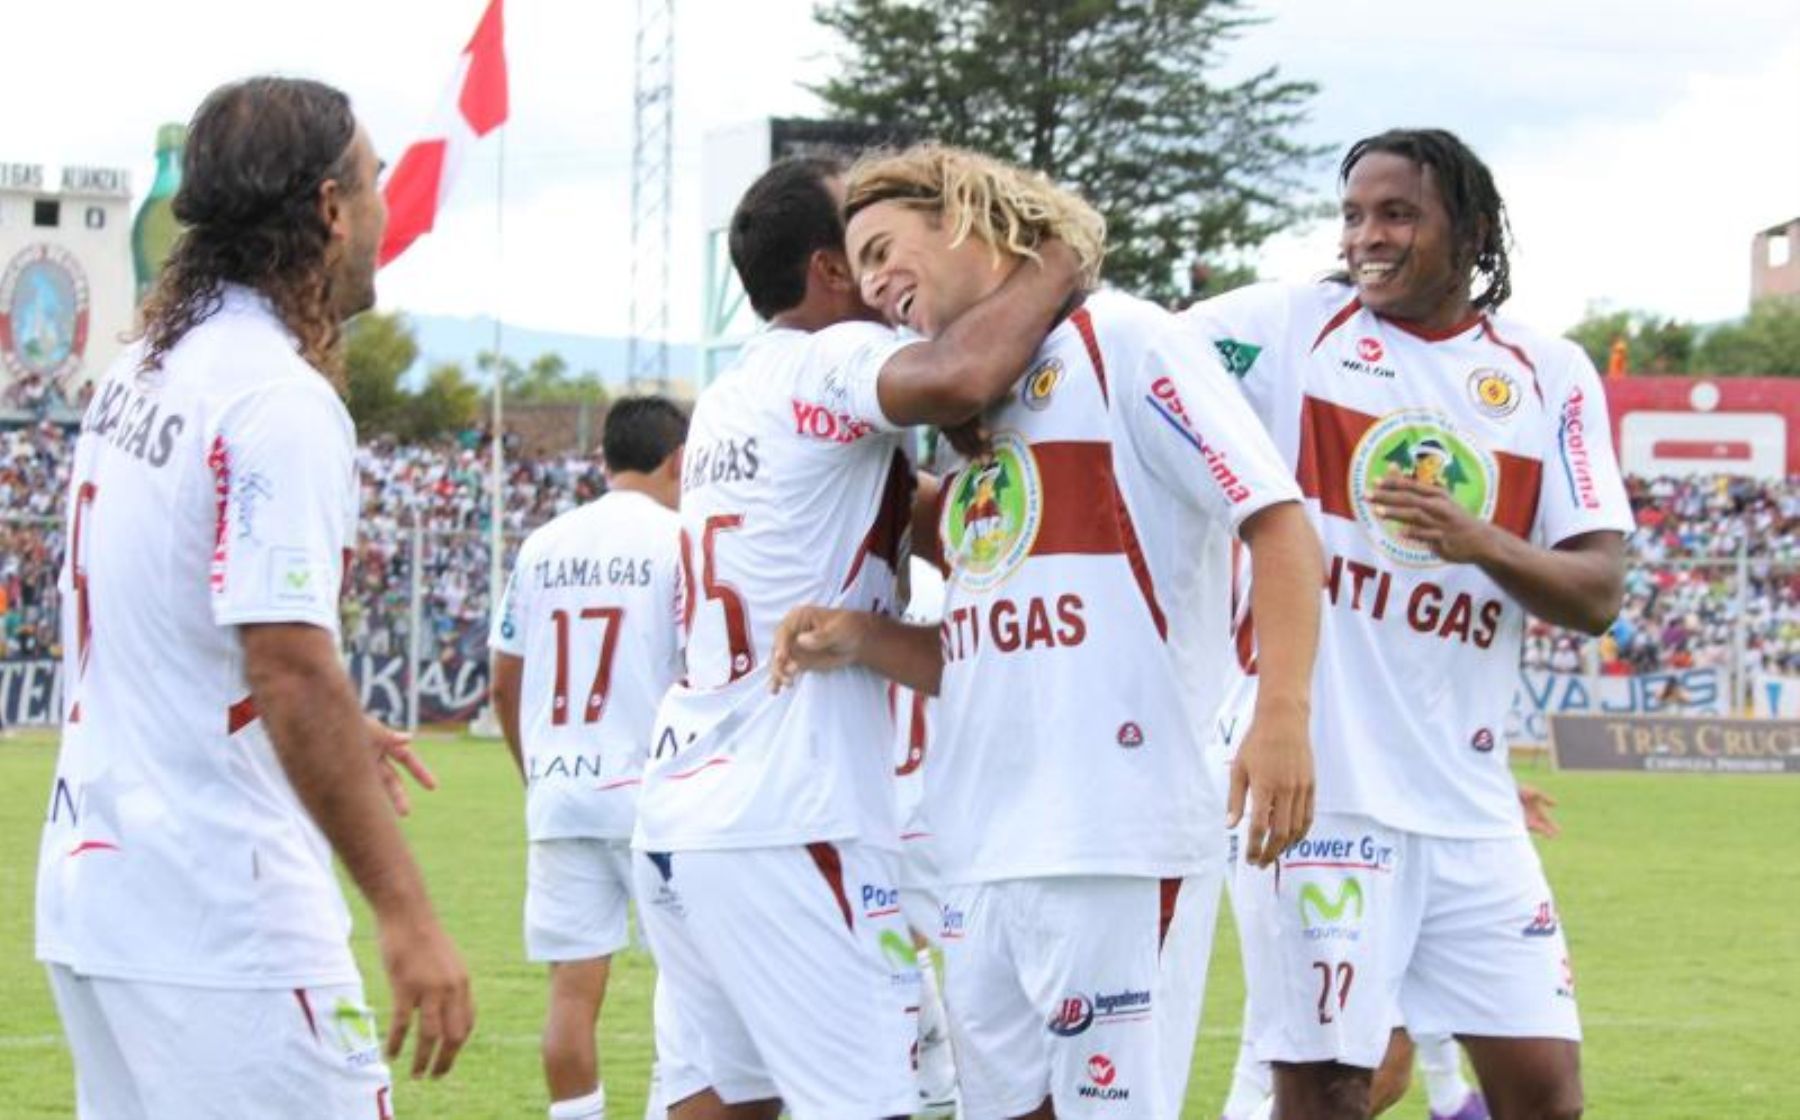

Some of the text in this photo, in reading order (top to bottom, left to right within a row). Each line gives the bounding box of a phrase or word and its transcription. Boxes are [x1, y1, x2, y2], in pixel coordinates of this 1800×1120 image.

[711, 437, 758, 482] GAS
[608, 557, 653, 588] GAS
[989, 593, 1087, 653] GAS
[1407, 581, 1503, 650] GAS
[552, 606, 625, 726] 17
